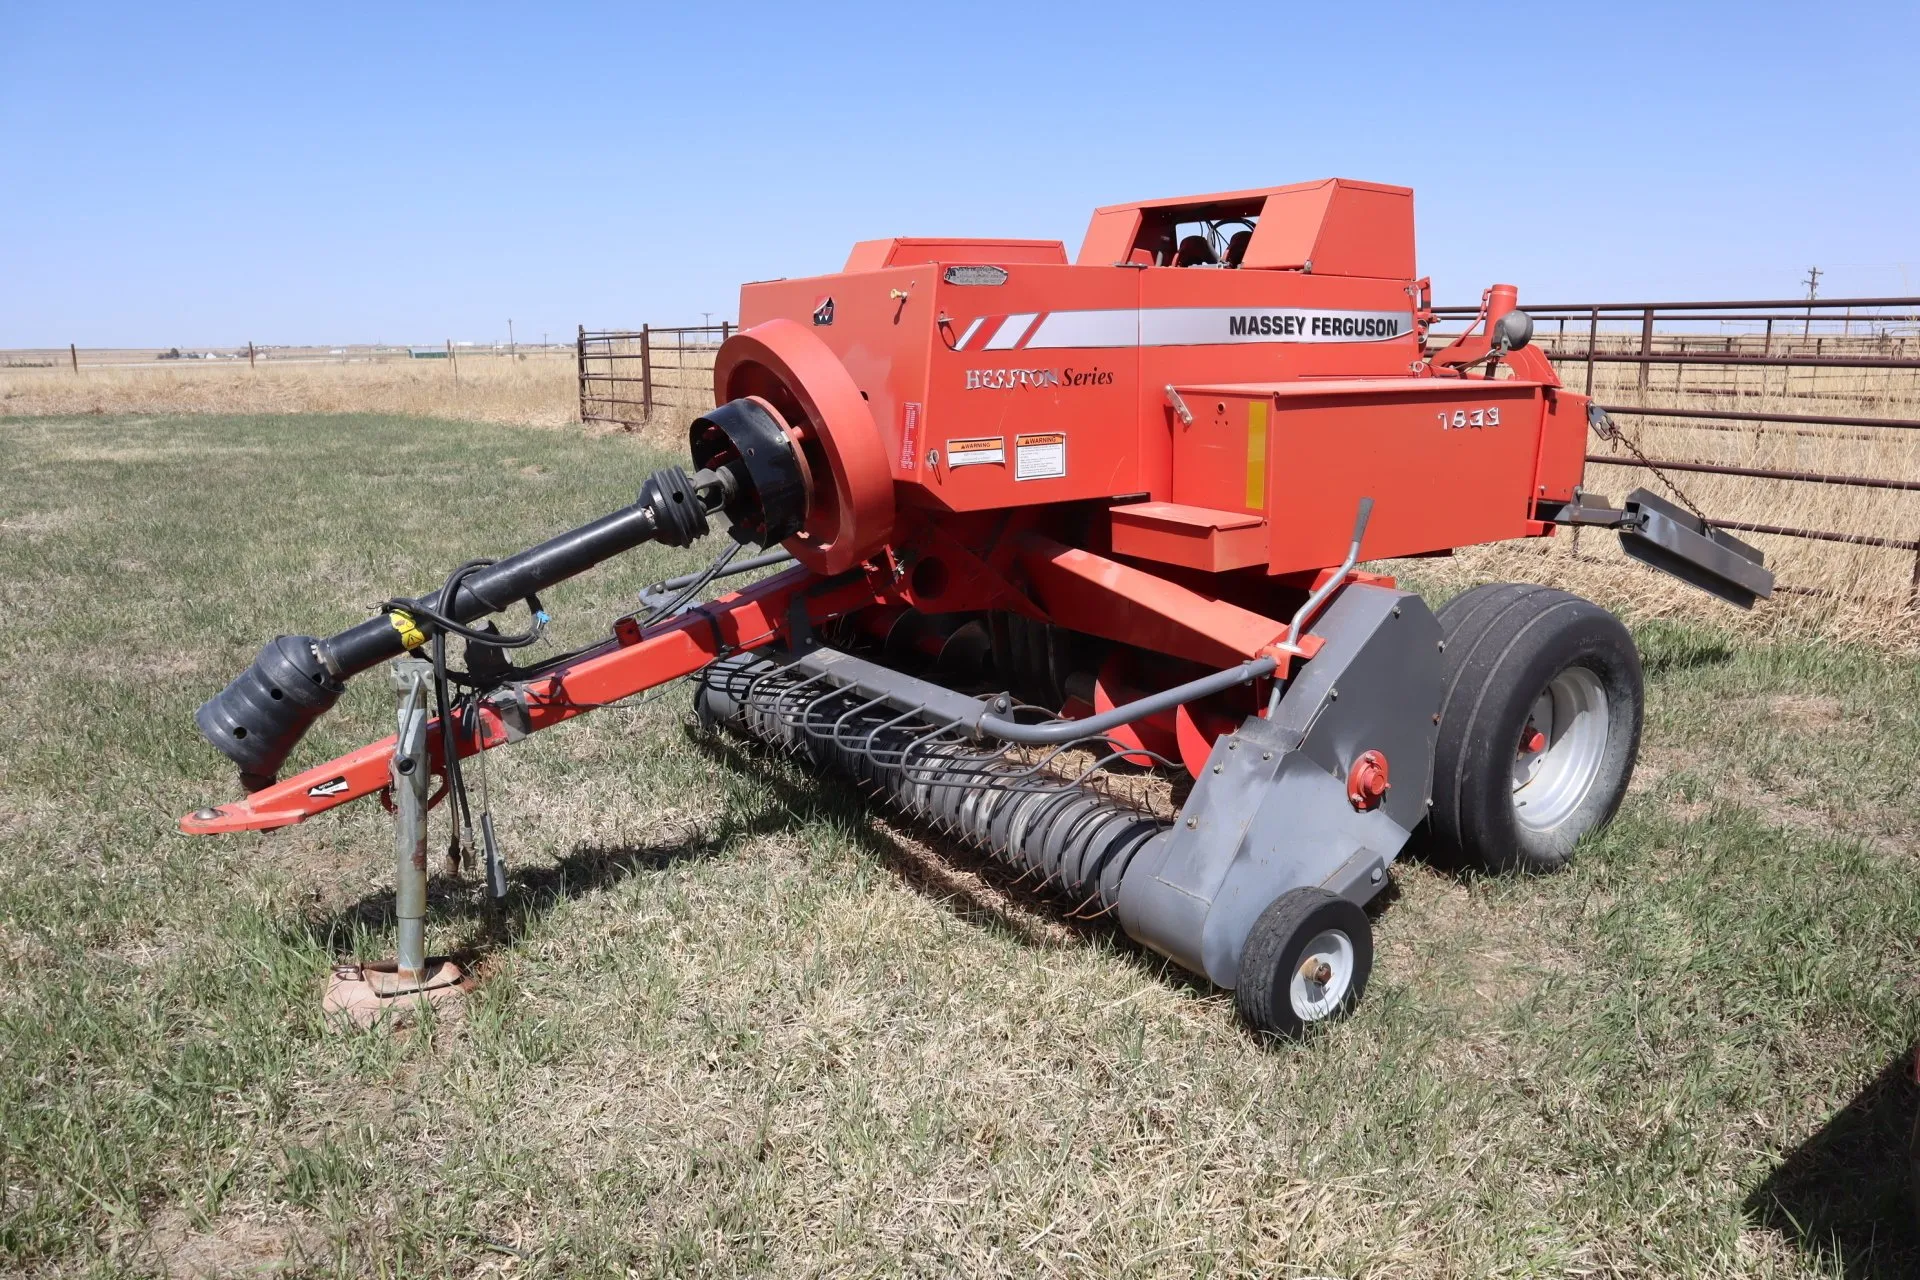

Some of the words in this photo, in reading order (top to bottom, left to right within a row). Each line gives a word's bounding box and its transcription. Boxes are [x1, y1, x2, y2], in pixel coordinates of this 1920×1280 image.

[1229, 316, 1306, 335] MASSEY
[1311, 317, 1398, 336] FERGUSON
[1062, 367, 1114, 387] Series
[1030, 436, 1057, 444] WARNING
